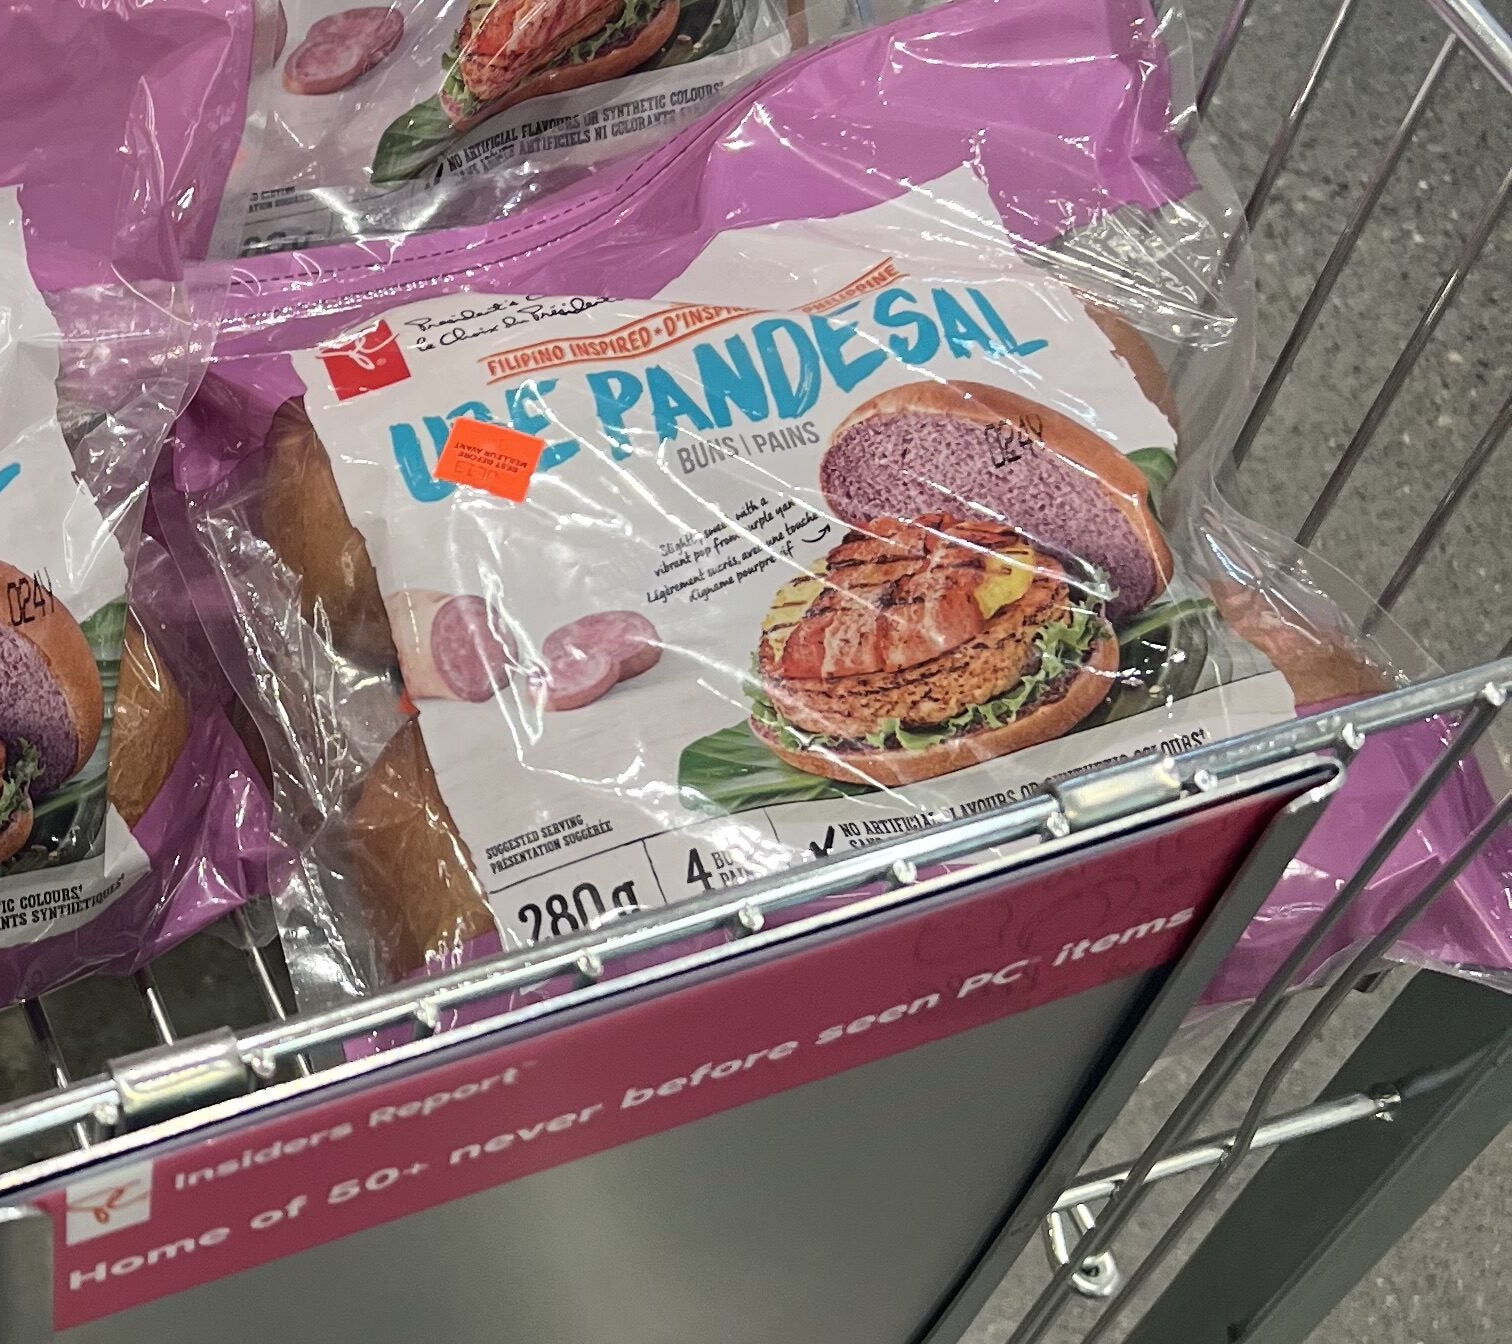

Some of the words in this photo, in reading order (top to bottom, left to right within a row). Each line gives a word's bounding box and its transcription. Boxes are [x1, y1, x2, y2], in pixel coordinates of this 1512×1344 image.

[447, 152, 464, 172] NO
[463, 130, 519, 163] ARTIFICIAL
[521, 113, 581, 139] FLAVOURS
[602, 94, 667, 123] SYNTHETIC
[594, 124, 609, 142] NI
[487, 344, 566, 378] FILIPINO
[568, 325, 653, 359] INSPIRED
[585, 286, 1050, 452] PANDESAL
[457, 450, 494, 467] BEFORE
[495, 461, 519, 474] BEST
[676, 435, 739, 477] BUNS
[751, 421, 821, 461] PAINS
[653, 552, 692, 577] vibrant
[693, 544, 712, 564] pop
[713, 533, 740, 555] from
[746, 509, 775, 533] urple
[658, 531, 705, 558] Slighty
[735, 500, 760, 521] with
[759, 496, 769, 506] a
[645, 569, 706, 604] Légèrement
[784, 511, 820, 536] touche
[735, 555, 777, 584] pourpre
[780, 540, 795, 558] if
[485, 829, 540, 859] SUGGESTED
[540, 813, 585, 838] SERVING
[563, 817, 614, 846] SUGGÉRÉE
[837, 821, 860, 838] NO
[947, 789, 1018, 820] LAVOURS
[685, 847, 713, 892] 4
[67, 1222, 232, 1291] Home
[248, 1194, 310, 1232] of
[326, 1160, 431, 1208] 50+
[448, 1102, 605, 1166] never
[618, 1039, 800, 1112] before
[813, 991, 943, 1047] seen
[1051, 905, 1197, 968] items
[173, 1119, 355, 1192] Insiders
[367, 1066, 520, 1130] Report
